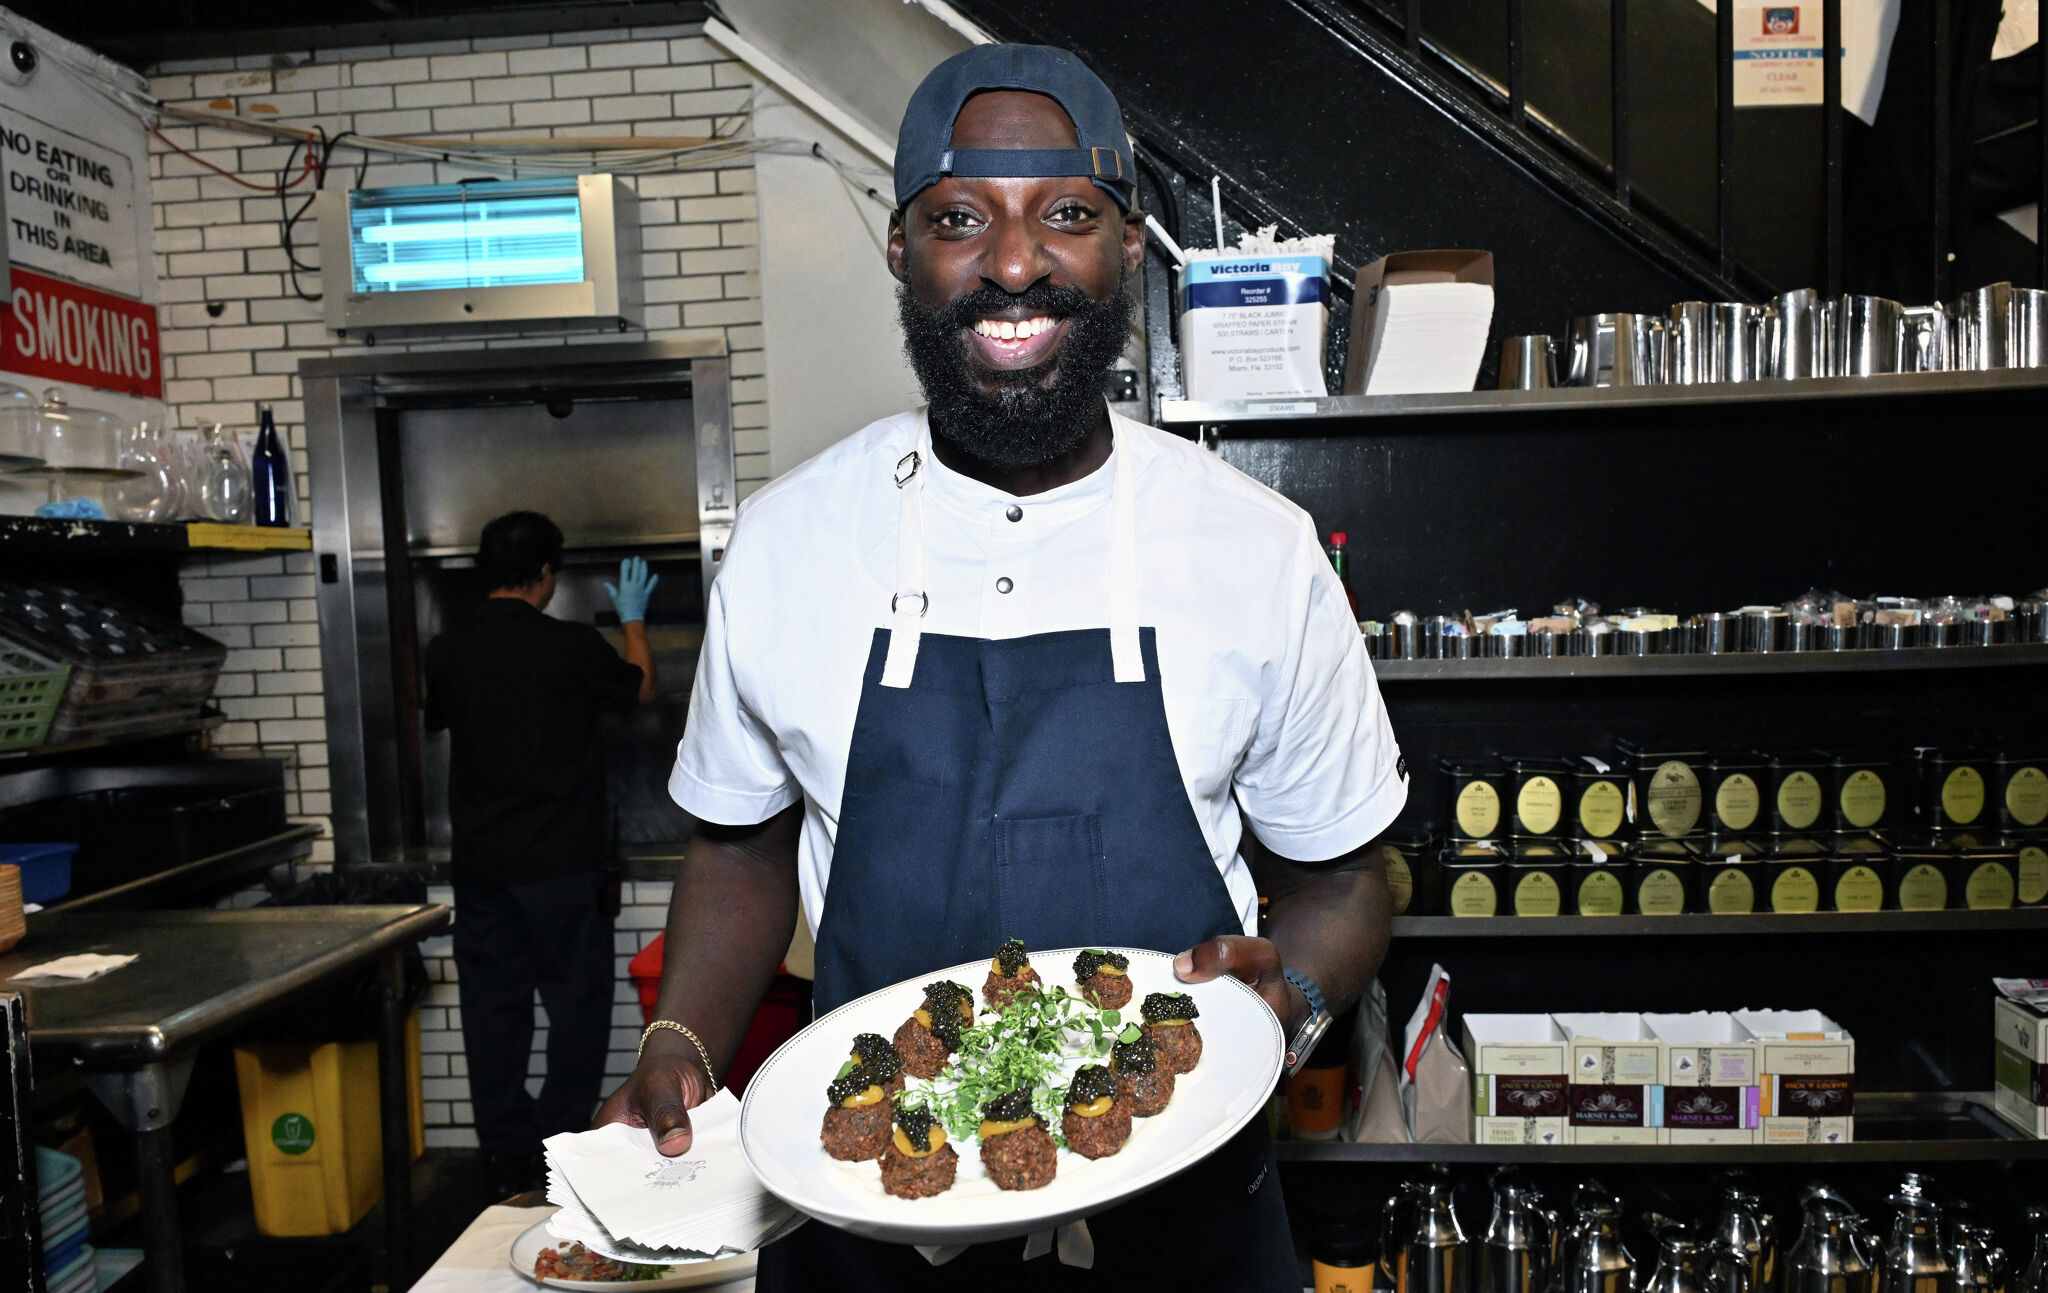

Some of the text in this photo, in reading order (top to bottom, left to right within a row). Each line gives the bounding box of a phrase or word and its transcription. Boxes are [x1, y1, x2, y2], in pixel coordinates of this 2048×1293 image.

[1750, 49, 1814, 59] NOTICE
[1766, 72, 1798, 80] CLEAR
[0, 125, 114, 188] NO EATING
[46, 167, 71, 186] OR
[10, 171, 109, 222] DRINKING
[53, 210, 71, 229] IN
[11, 218, 113, 268] THIS AREA
[1210, 262, 1270, 274] Victoria
[1272, 262, 1301, 273] Bay
[1241, 287, 1265, 295] Reorder
[1240, 311, 1262, 319] BLACK
[1212, 320, 1248, 329] WRAPPED
[1249, 319, 1272, 328] PAPER
[12, 286, 152, 380] SMOKING
[1217, 330, 1229, 338] 500
[1230, 328, 1260, 337] STRAWS
[1264, 327, 1294, 336] CARTN
[1211, 345, 1300, 355] www.victoriabayproductscom
[1816, 1081, 1848, 1089] HARNEY
[1576, 1112, 1638, 1120] HARNEY & SONS
[1671, 1113, 1735, 1121] HARNEY & SONS
